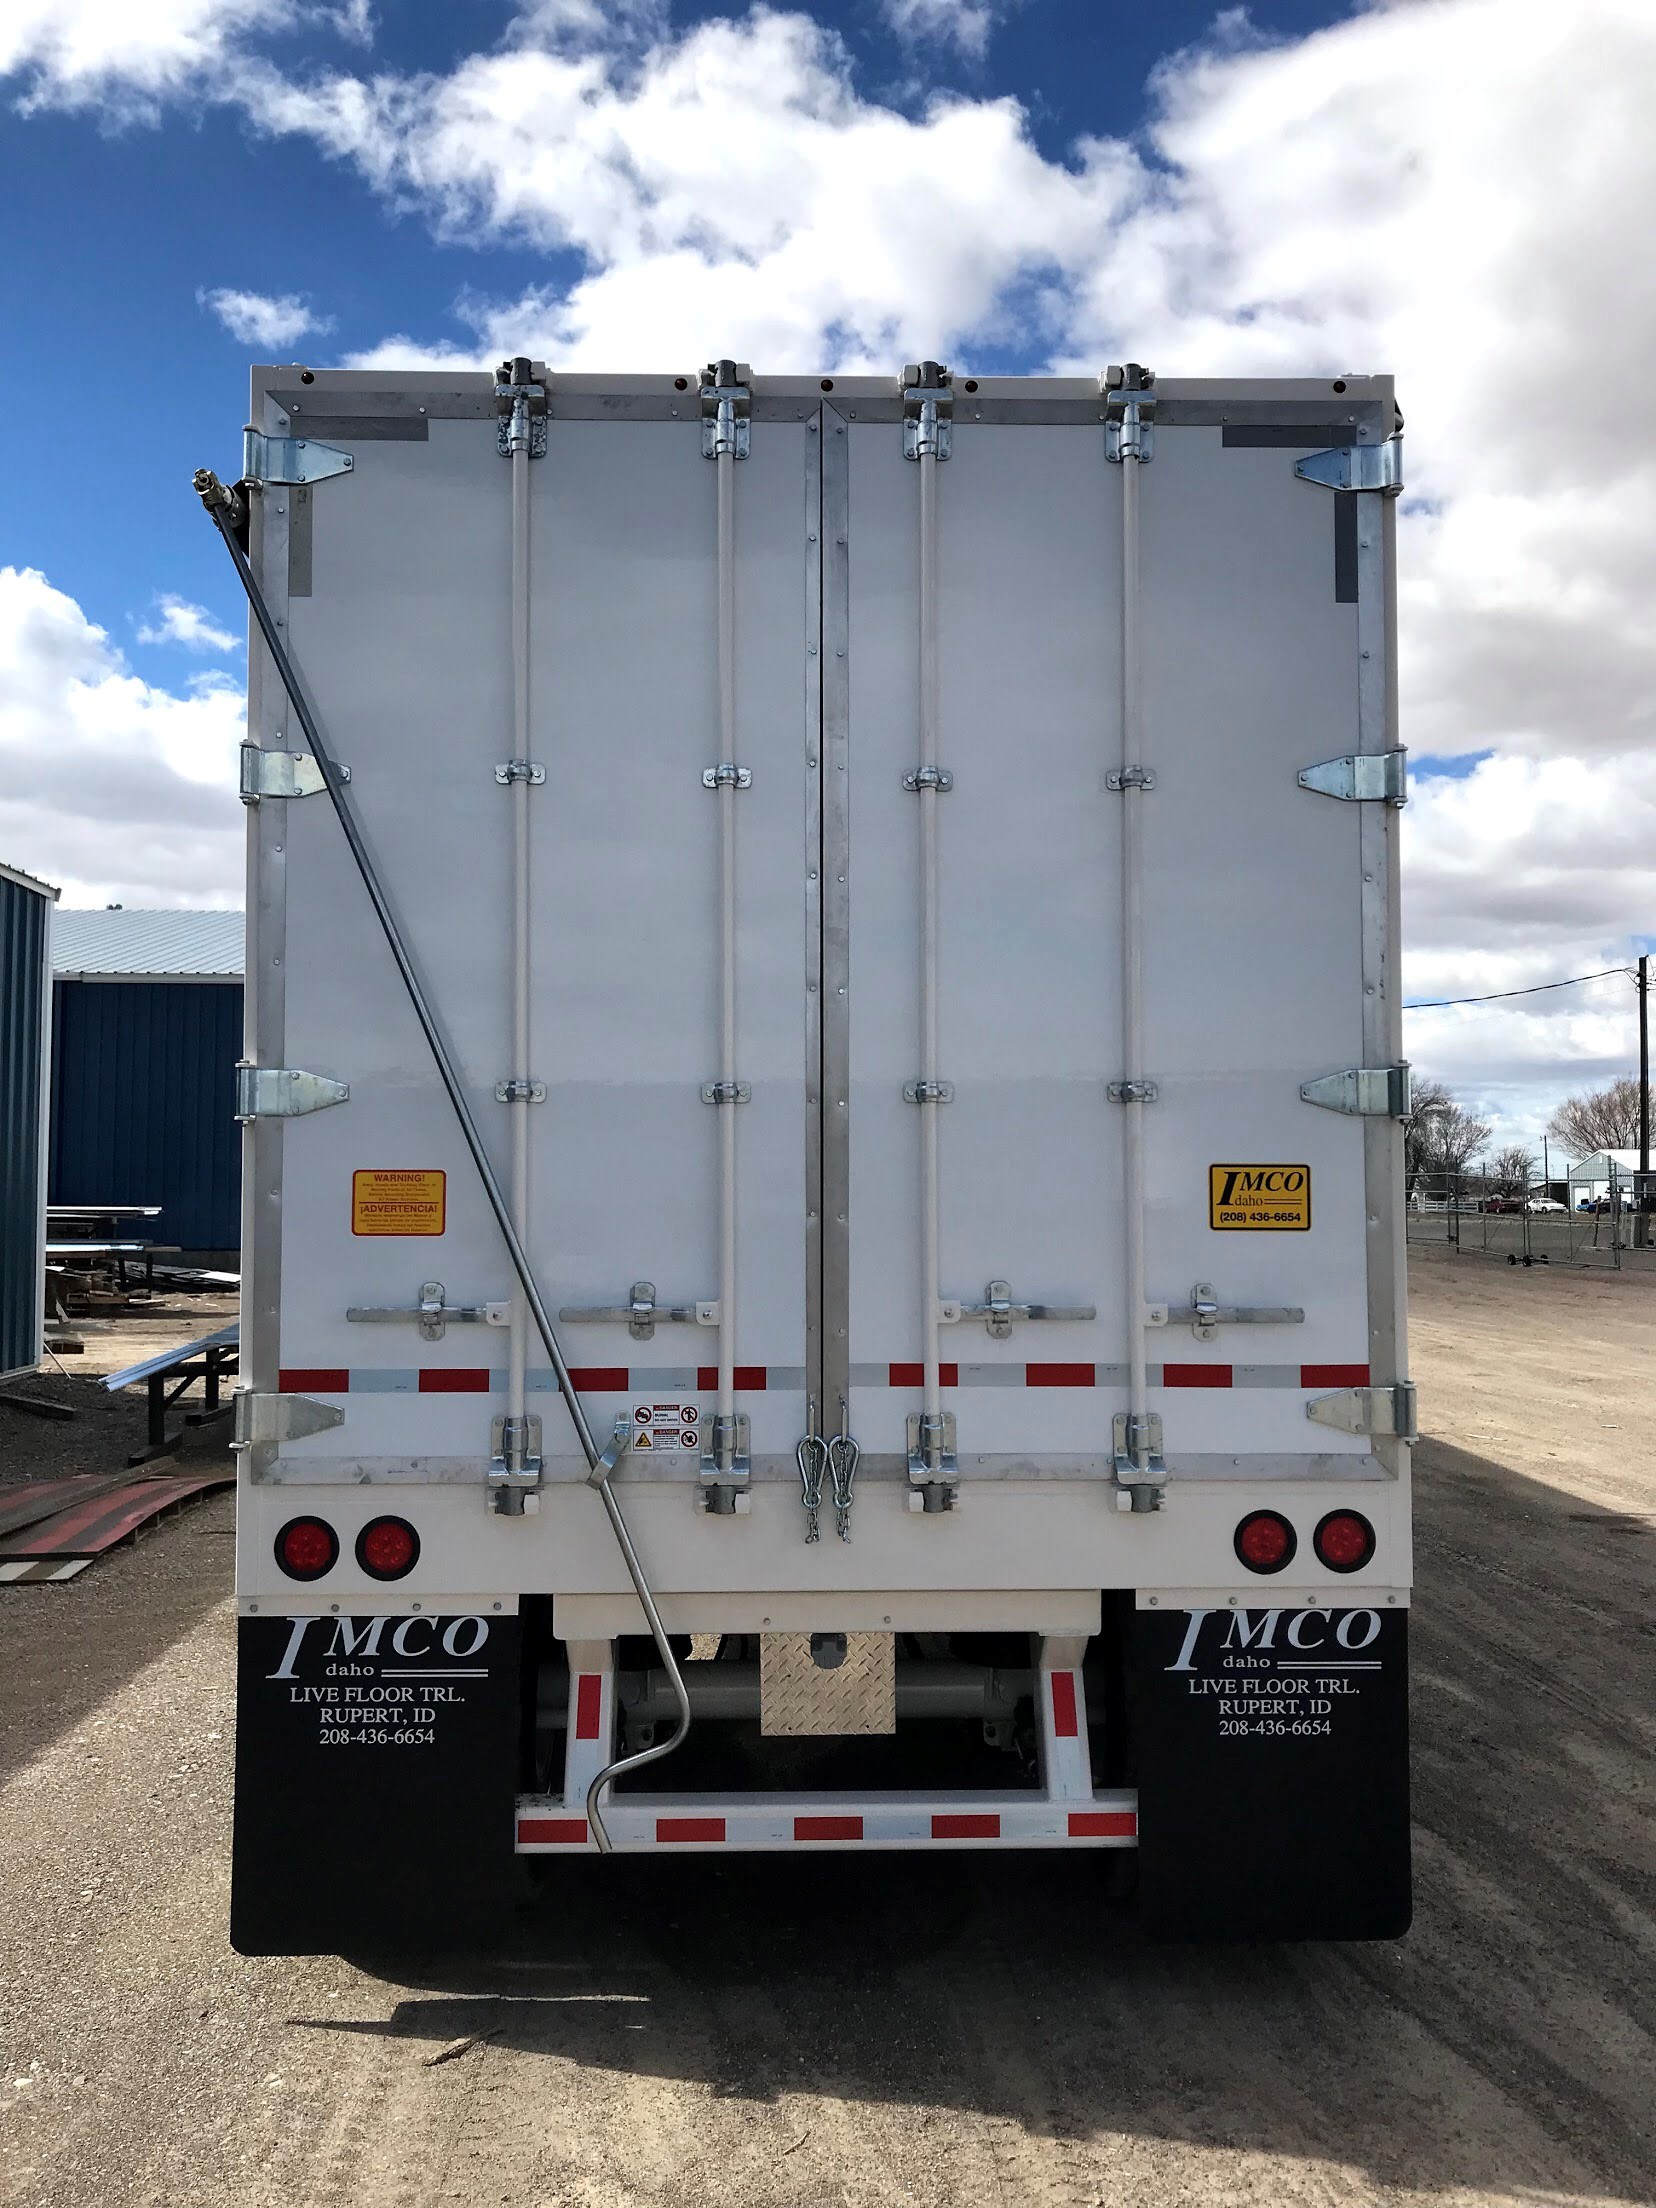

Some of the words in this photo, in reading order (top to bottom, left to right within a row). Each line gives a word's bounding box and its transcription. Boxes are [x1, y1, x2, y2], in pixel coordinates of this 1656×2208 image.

[374, 1174, 425, 1182] WARNING!
[1216, 1171, 1304, 1206] IMCO
[360, 1204, 437, 1214] ¡ADVERTENCIA!
[1220, 1212, 1247, 1223] (208)
[1250, 1212, 1301, 1221] 436-6654
[265, 1615, 490, 1679] IMCO
[1164, 1609, 1382, 1671] IMCO
[290, 1687, 339, 1703] LIVE
[344, 1687, 415, 1703] FLOOR
[419, 1686, 465, 1702] TRL.
[1188, 1679, 1237, 1694] LIVE
[1242, 1679, 1311, 1694] FLOOR
[1315, 1679, 1360, 1694] TRL.
[320, 1707, 408, 1725] RUPERT,
[413, 1707, 436, 1723] ID
[1218, 1699, 1305, 1717] RUPERT,
[1309, 1699, 1332, 1715] ID
[1219, 1719, 1332, 1736] 208-436-6654
[319, 1728, 436, 1745] 208-436-6654
